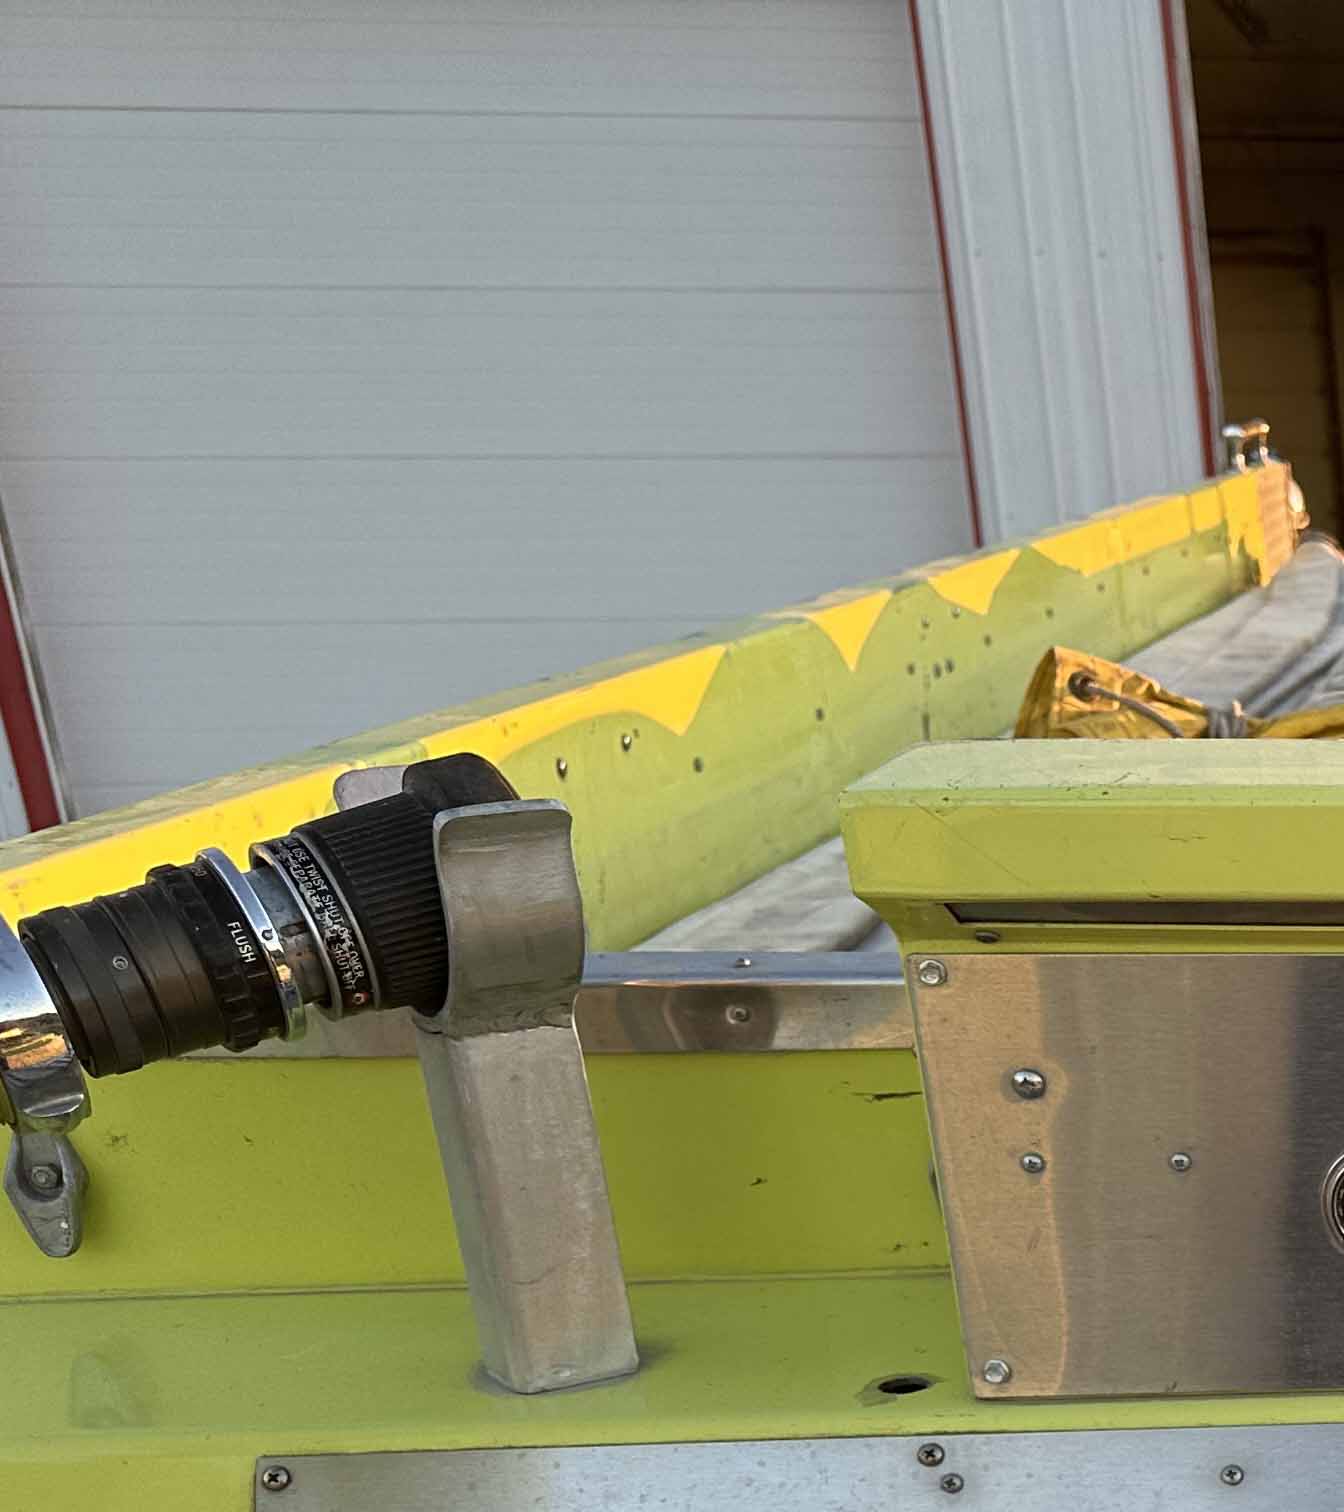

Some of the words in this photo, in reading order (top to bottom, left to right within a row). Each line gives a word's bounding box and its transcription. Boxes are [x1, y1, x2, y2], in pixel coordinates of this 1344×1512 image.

[306, 863, 328, 892] TWIST
[322, 893, 345, 925] SHUT
[227, 921, 257, 963] FLUSH
